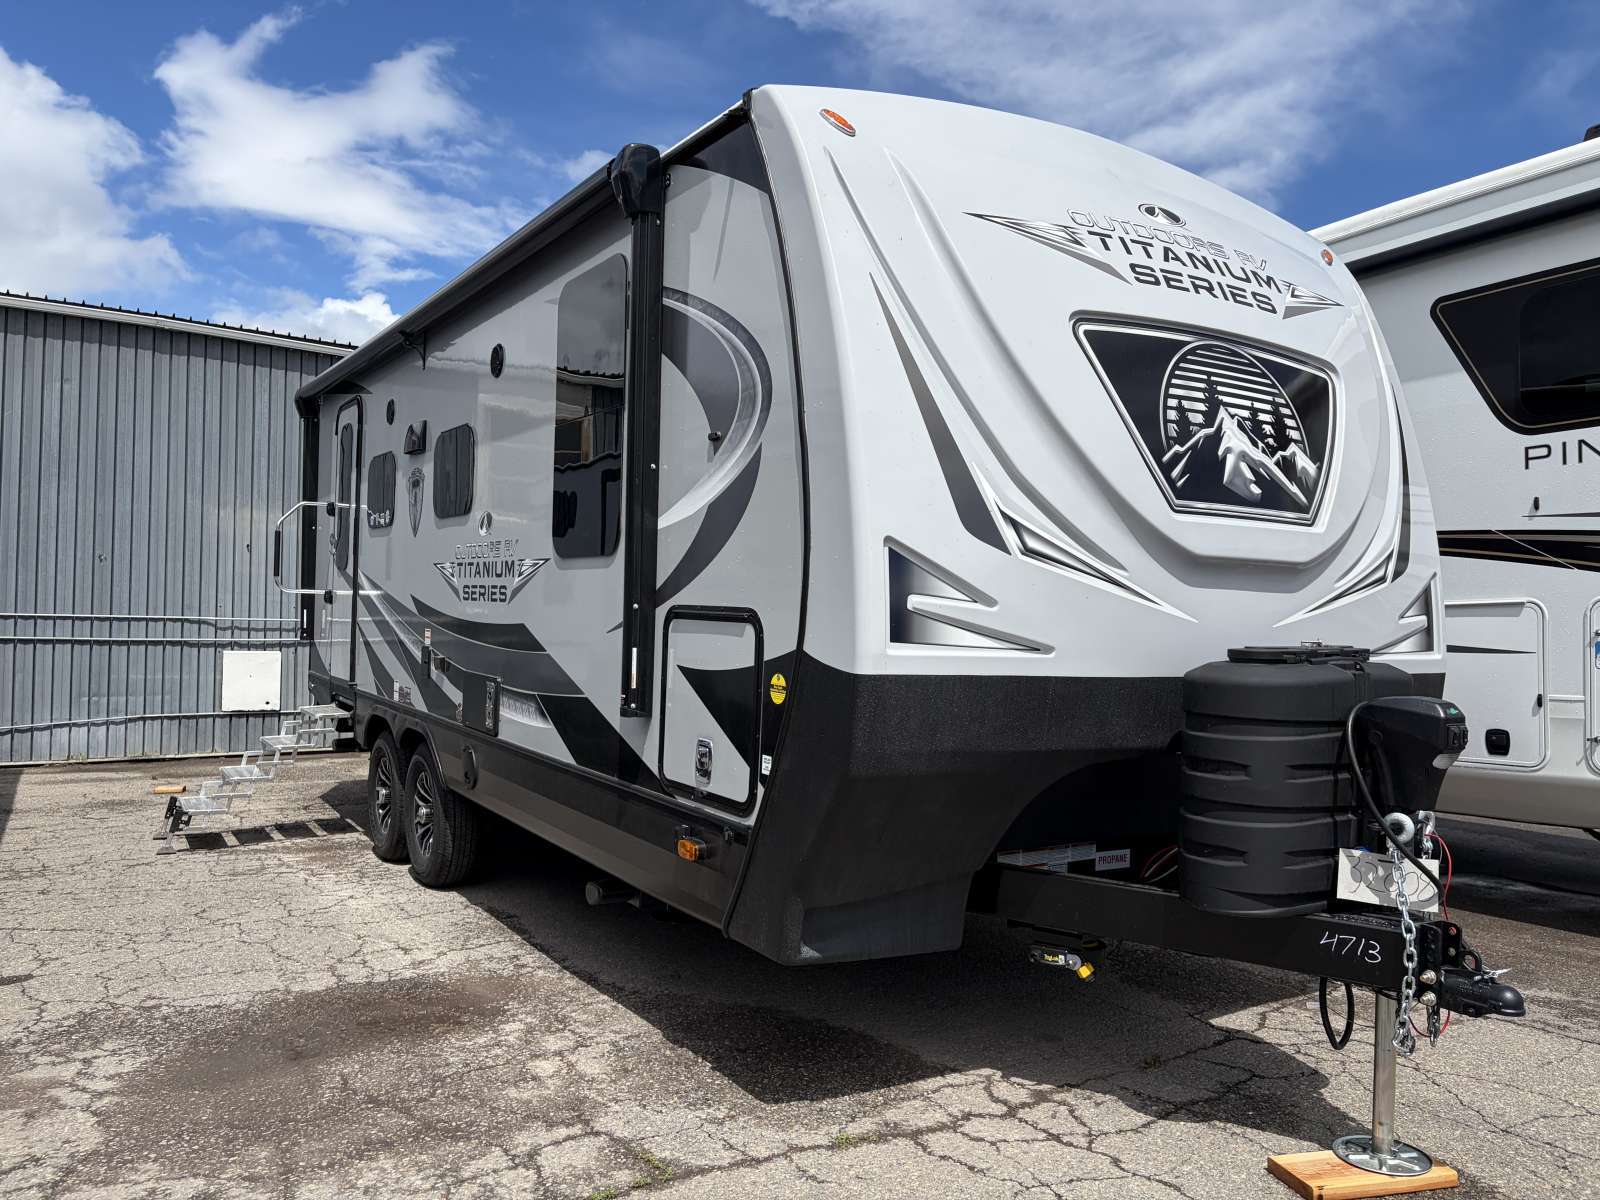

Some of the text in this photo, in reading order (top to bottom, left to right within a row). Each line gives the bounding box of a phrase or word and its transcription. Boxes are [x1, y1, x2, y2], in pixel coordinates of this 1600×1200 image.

[1066, 207, 1267, 271] OUTDOORS RV
[1087, 229, 1283, 294] TITANIUM
[1129, 263, 1278, 314] SERIES
[456, 560, 515, 579] TITANIUM
[462, 584, 508, 603] SERIES
[1098, 853, 1129, 865] PROPANE
[1319, 930, 1382, 963] 4713
